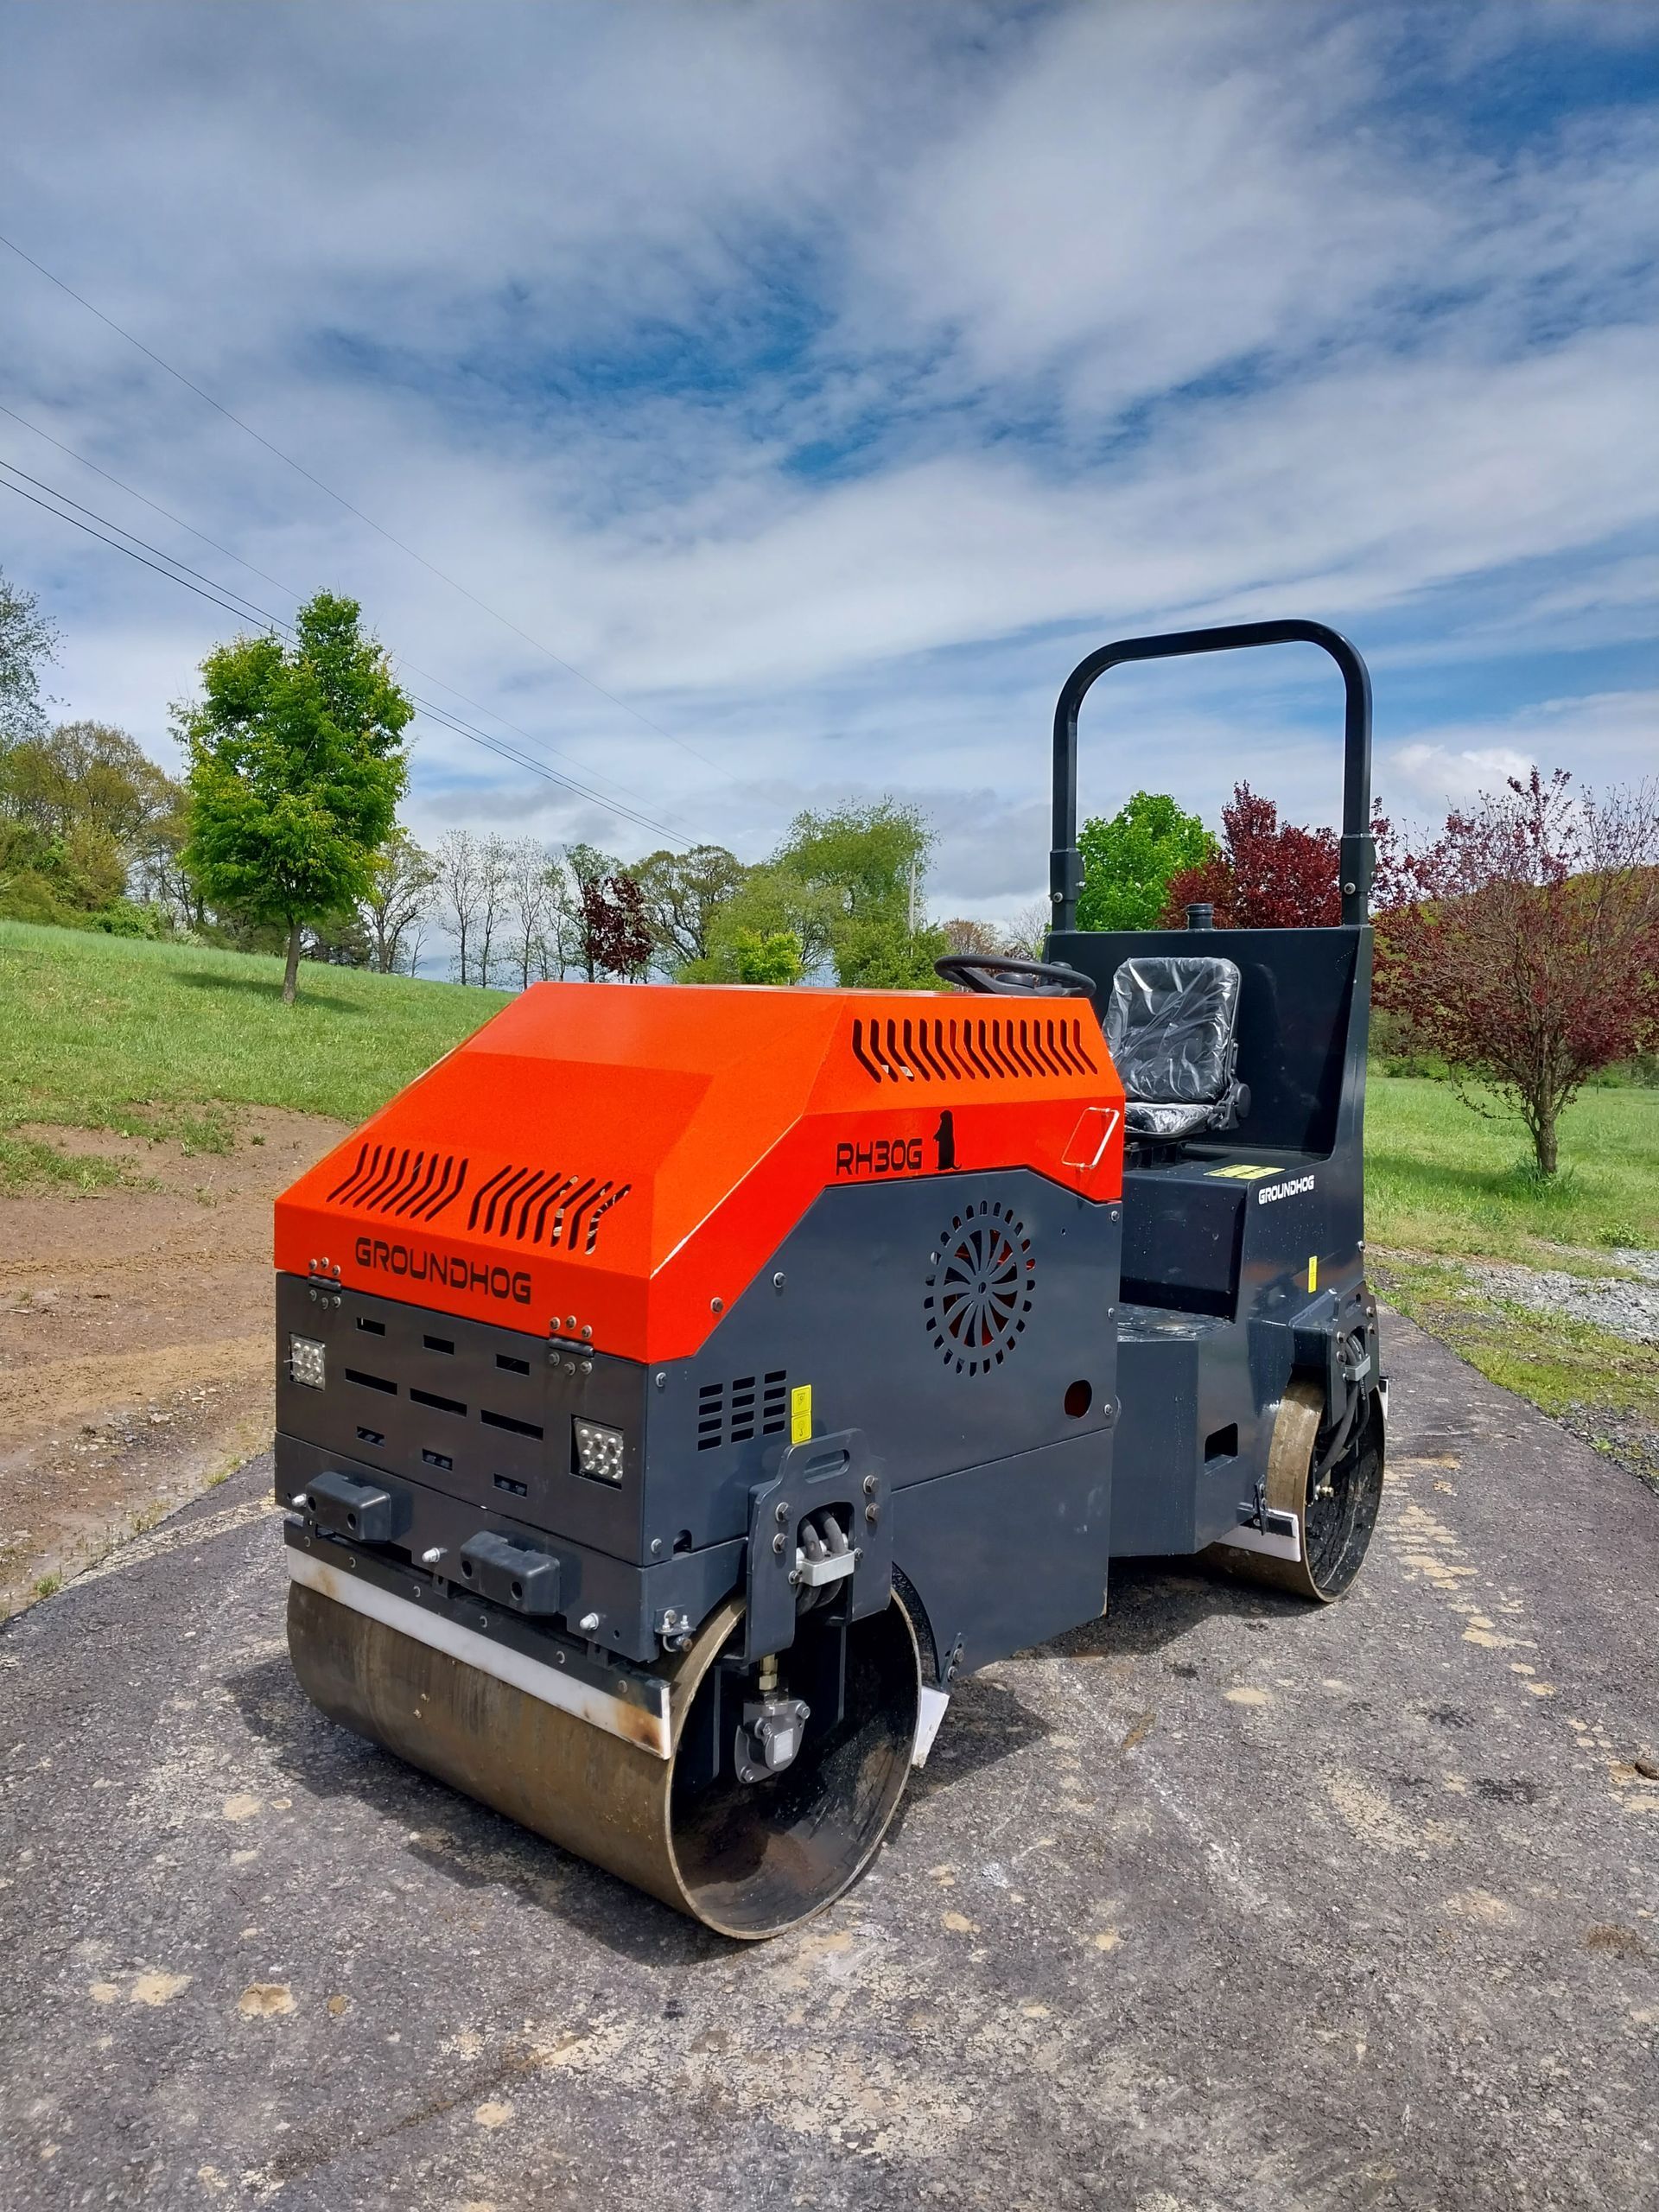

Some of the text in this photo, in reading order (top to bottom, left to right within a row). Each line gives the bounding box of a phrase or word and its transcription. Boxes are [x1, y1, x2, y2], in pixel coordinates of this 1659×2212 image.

[836, 1138, 922, 1175] RH30G
[1258, 1174, 1314, 1205] GROUNDHOG
[355, 1236, 531, 1305] GROUNDHOG
